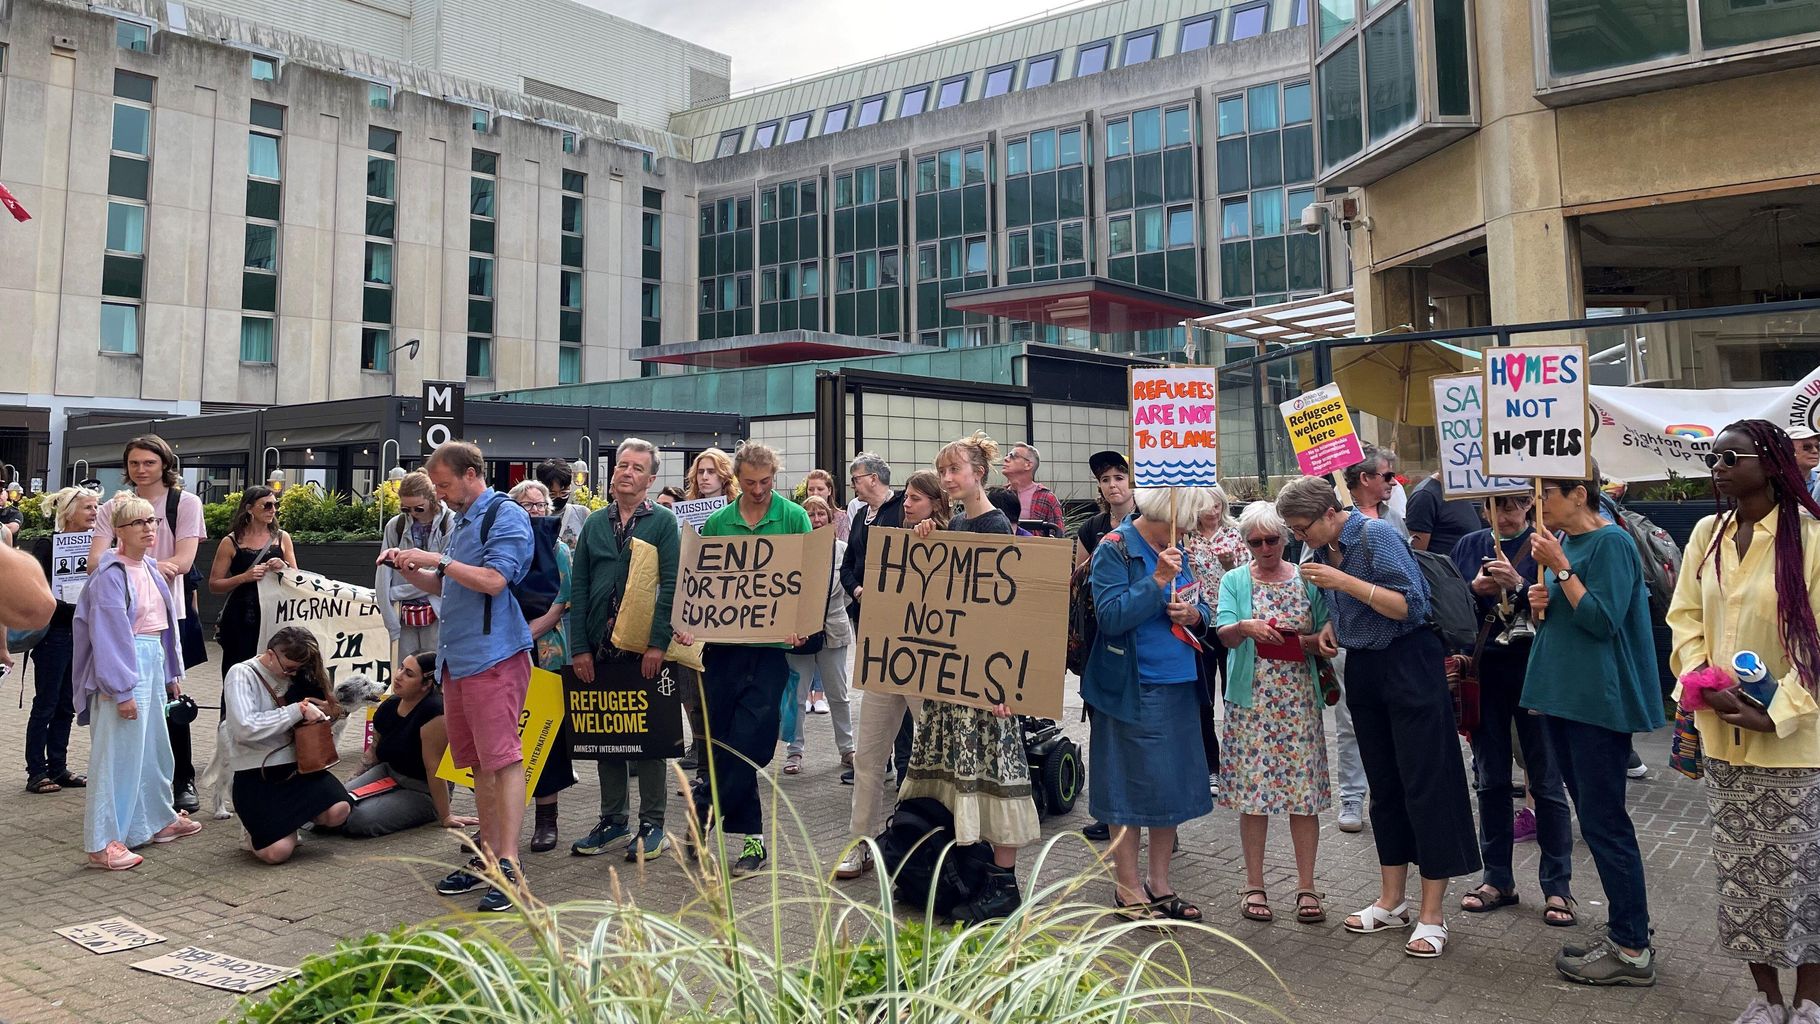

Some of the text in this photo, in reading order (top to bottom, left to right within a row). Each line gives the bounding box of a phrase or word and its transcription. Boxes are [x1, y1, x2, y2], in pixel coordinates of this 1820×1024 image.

[1134, 380, 1214, 400] REFUGEES
[1135, 404, 1215, 425] ARE NOT
[1289, 401, 1341, 427] Refugees
[1506, 398, 1557, 418] NOT
[1294, 413, 1344, 438] welcome
[1309, 429, 1336, 445] here
[1135, 430, 1216, 449] TO BLAME
[1493, 428, 1582, 457] HOTELS
[1450, 441, 1483, 466] SA
[676, 499, 724, 514] MISSING!
[697, 539, 773, 570] END
[682, 567, 802, 600] FORTRESS
[682, 600, 778, 629] EUROPE!
[904, 601, 966, 637] NOT
[330, 632, 363, 659] in
[862, 637, 1029, 704] HOTELS!
[570, 690, 648, 711] REFUGEES
[571, 712, 648, 734] WELCOME
[530, 719, 553, 765] INTERNATIONAL
[574, 745, 643, 753] AMNESTY INTERNATIONAL
